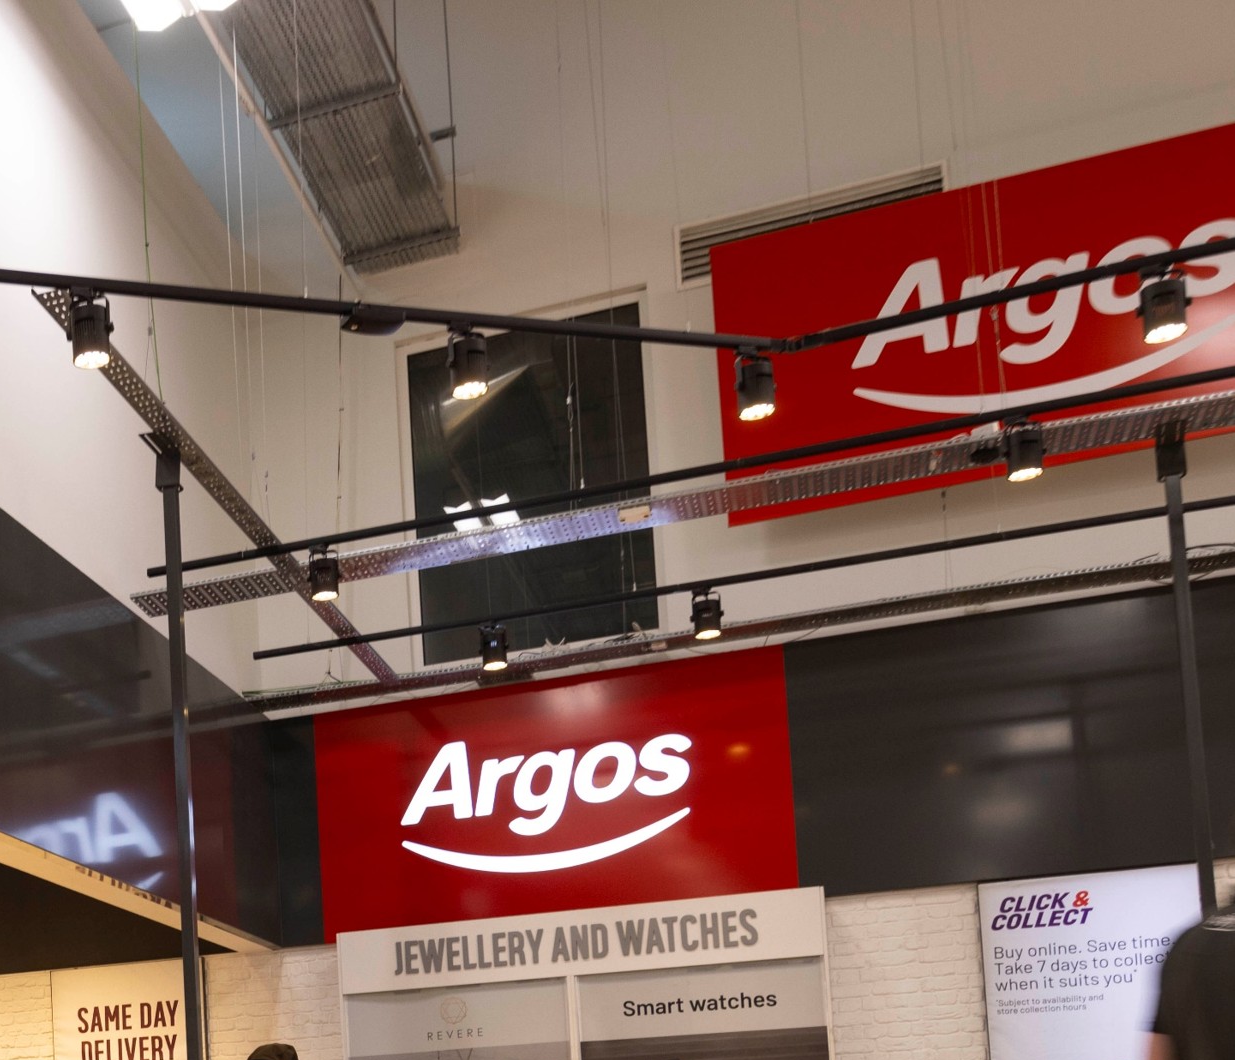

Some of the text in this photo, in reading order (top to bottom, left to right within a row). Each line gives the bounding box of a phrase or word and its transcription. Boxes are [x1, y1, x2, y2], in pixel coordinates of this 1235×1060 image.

[851, 217, 1235, 370] Argos
[400, 733, 692, 836] Argos
[1000, 890, 1090, 914] CLICK &
[991, 907, 1093, 931] COLLECT
[394, 908, 759, 976] JEWELLERY AND WATCHES
[994, 936, 1176, 962] Buy online. Save time.
[994, 961, 1032, 976] Take
[1036, 960, 1046, 973] 7
[1050, 960, 1088, 974] days
[1092, 957, 1109, 968] to
[995, 978, 1038, 992] when
[1043, 976, 1054, 988] it
[1060, 974, 1100, 988] suits
[622, 992, 778, 1017] Smart watches
[1020, 1006, 1062, 1014] collection
[1062, 1004, 1086, 1012] hours
[1042, 995, 1086, 1004] availability
[1088, 994, 1104, 1002] and
[77, 1000, 179, 1034] SAME DAY
[427, 1027, 484, 1041] REVERE
